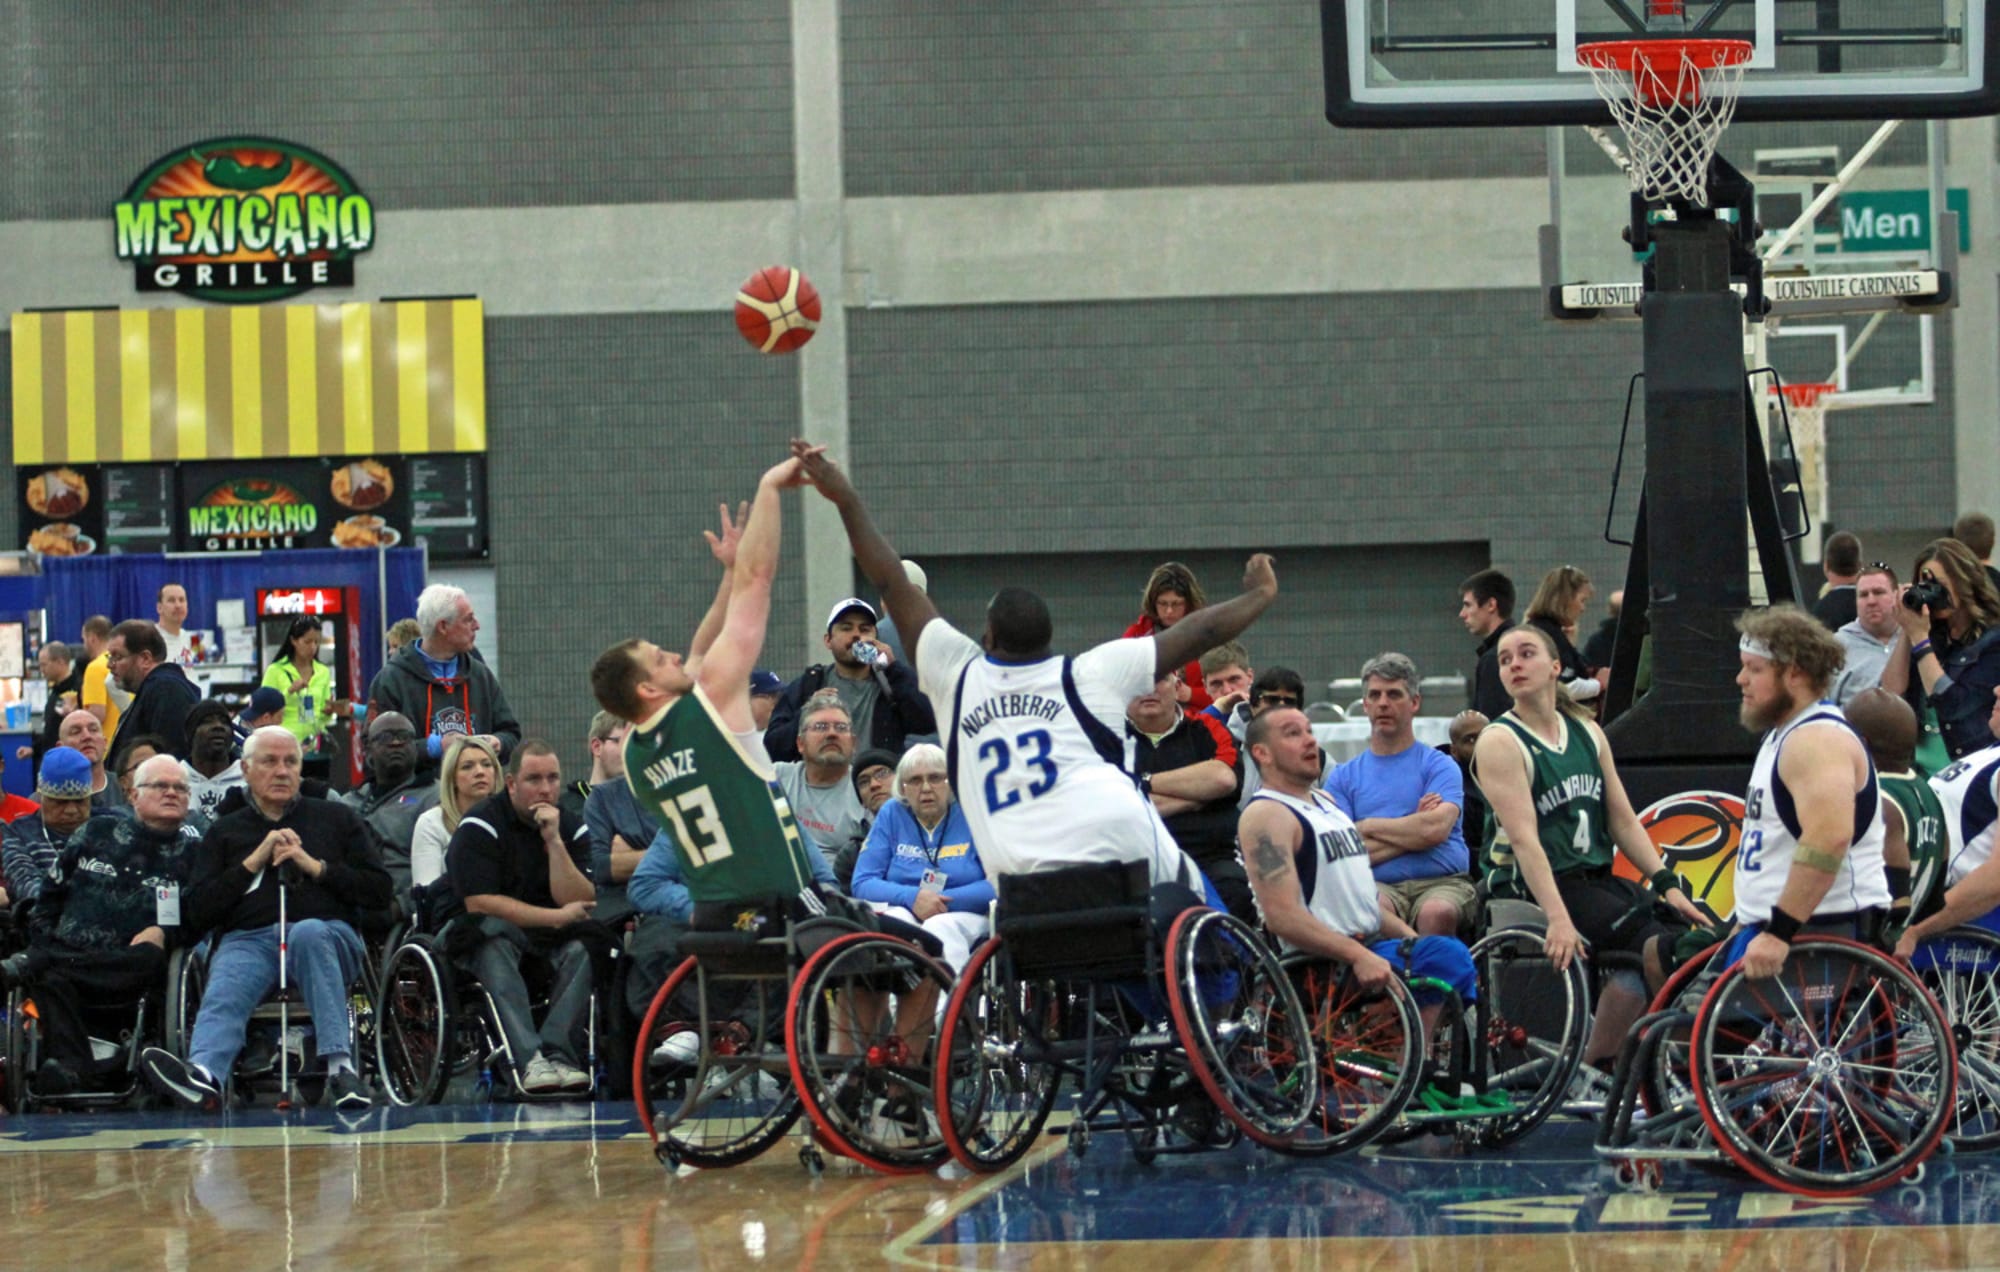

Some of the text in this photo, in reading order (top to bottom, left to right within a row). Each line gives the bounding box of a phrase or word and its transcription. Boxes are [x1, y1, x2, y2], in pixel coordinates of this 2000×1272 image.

[116, 193, 373, 258] MEXICANO
[1842, 206, 1921, 240] Men
[154, 260, 329, 287] GRILLE
[1775, 275, 1920, 300] LOUISVILLE CARDINALS
[189, 503, 318, 537] MEXICANO
[206, 535, 294, 551] GRILLE
[977, 727, 1059, 816] 23
[659, 783, 734, 869] 13
[1572, 808, 1591, 854] 4
